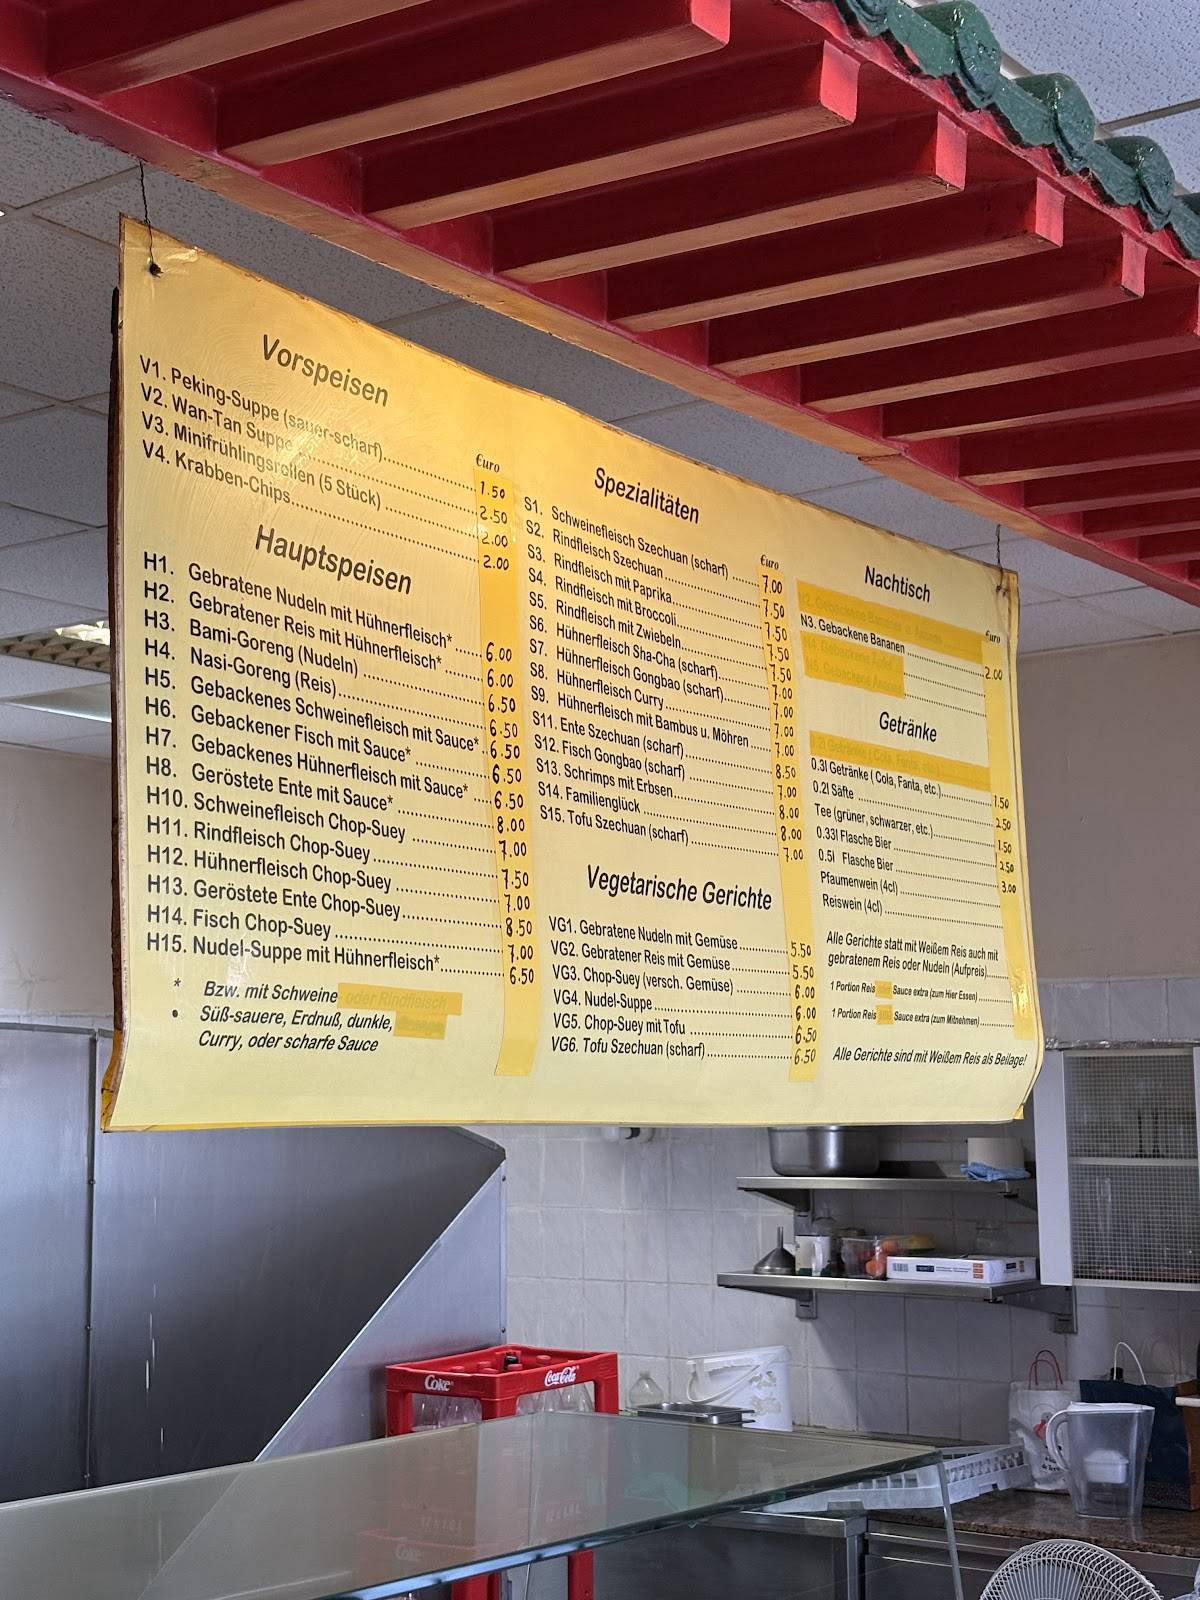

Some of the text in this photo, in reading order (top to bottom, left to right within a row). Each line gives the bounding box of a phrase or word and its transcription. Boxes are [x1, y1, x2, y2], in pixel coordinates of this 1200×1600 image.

[139, 354, 167, 382] V1.
[171, 368, 279, 421] Peking-Suppe
[263, 334, 389, 407] Vorspeisen
[141, 411, 169, 438] V3.
[336, 481, 382, 511] Stück)
[142, 439, 170, 464] V4.
[175, 450, 291, 505] Krabben-Chips
[594, 467, 700, 524] Spezialitäten
[255, 524, 412, 595] Hauptspeisen
[525, 497, 543, 515] S1.
[552, 506, 635, 549] Schweinefleisch
[636, 537, 688, 565] Szechuan
[691, 554, 728, 581] (scharf)
[144, 551, 174, 576] H1.
[189, 563, 272, 600] Gebratene
[276, 586, 326, 616] Nudeln
[331, 605, 353, 623] mit
[528, 544, 545, 563] S3.
[554, 552, 612, 585] Rindfleisch
[615, 576, 631, 590] mit
[633, 579, 672, 604] Paprika
[865, 565, 931, 603] Nachtisch
[145, 609, 175, 632] H3.
[190, 618, 296, 664] Bami-Goreng
[298, 645, 358, 679] (Nudeln)
[801, 613, 816, 629] N3.
[819, 619, 868, 643] Gebackene
[870, 633, 905, 654] Bananen
[530, 638, 547, 657] S7.
[557, 645, 630, 679] Hühnerfleisch
[633, 666, 680, 691] Gongbao
[683, 678, 723, 704] (scharf)
[531, 685, 548, 704] S9.
[558, 691, 633, 723] Hühnerfleisch
[636, 712, 653, 727] mit
[655, 714, 698, 736] Bambus
[701, 727, 709, 739] u.
[713, 727, 748, 748] Möhren
[533, 710, 557, 730] S11.
[560, 717, 585, 736] Ente
[588, 723, 640, 749] Szechuan
[643, 734, 683, 760] (scharf)
[879, 711, 937, 743] Getränke
[147, 756, 176, 778] H8.
[192, 763, 273, 792] Geröstete
[279, 776, 312, 800] Ente
[317, 785, 340, 804] mit
[538, 781, 563, 800] S14.
[566, 786, 640, 814] Familienglück
[831, 784, 854, 799] Säfte
[147, 785, 188, 808] H10.
[194, 792, 324, 828] Schweinefleisch
[329, 813, 405, 844] Chop-Suey
[814, 803, 831, 818] Tee
[916, 823, 933, 839] etc.)
[148, 844, 188, 867] H12.
[194, 850, 308, 880] Hühnerfleisch
[312, 864, 391, 894] Chop-Suey
[842, 852, 875, 868] Flasche
[877, 857, 893, 871] Bier
[148, 874, 187, 896] H13.
[194, 879, 277, 904] Geröstete
[283, 888, 317, 911] Ente
[321, 893, 400, 922] Chop-Suey
[587, 864, 772, 910] Vegetarische Gerichte
[880, 879, 898, 896] (4cl)
[147, 932, 186, 953] H15.
[193, 936, 302, 964] Nudel-Suppe
[307, 946, 331, 963] mit
[549, 915, 576, 934] VG1.
[580, 920, 636, 940] Gebratene
[638, 926, 673, 944] Nudeln
[675, 932, 693, 946] mit
[695, 933, 738, 949] Gemüse
[827, 931, 998, 961] Alle Gerichte statt mit Weißem Reis auch mit
[204, 981, 338, 1003] Bzw. mit Schweine
[552, 964, 580, 981] VG3.
[583, 967, 640, 989] Chop-Suey
[643, 972, 682, 990] (versch.
[686, 976, 733, 996] Gemüse)
[836, 981, 860, 992] Portion
[861, 983, 875, 993] Reis
[200, 1005, 286, 1028] Süß-sauere,
[291, 1010, 342, 1030] Erdnuß,
[347, 1013, 392, 1032] dunkle,
[553, 1012, 580, 1029] VG5.
[585, 1014, 643, 1036] Chop-Suey
[646, 1018, 662, 1034] mit
[663, 1019, 685, 1035] Tofu
[199, 1030, 378, 1052] Curry, oder scharfe Sauce
[833, 1047, 1027, 1068] Alle Gerichte sind mit Weißem Reis als Beilage!
[424, 1374, 451, 1392] Coke
